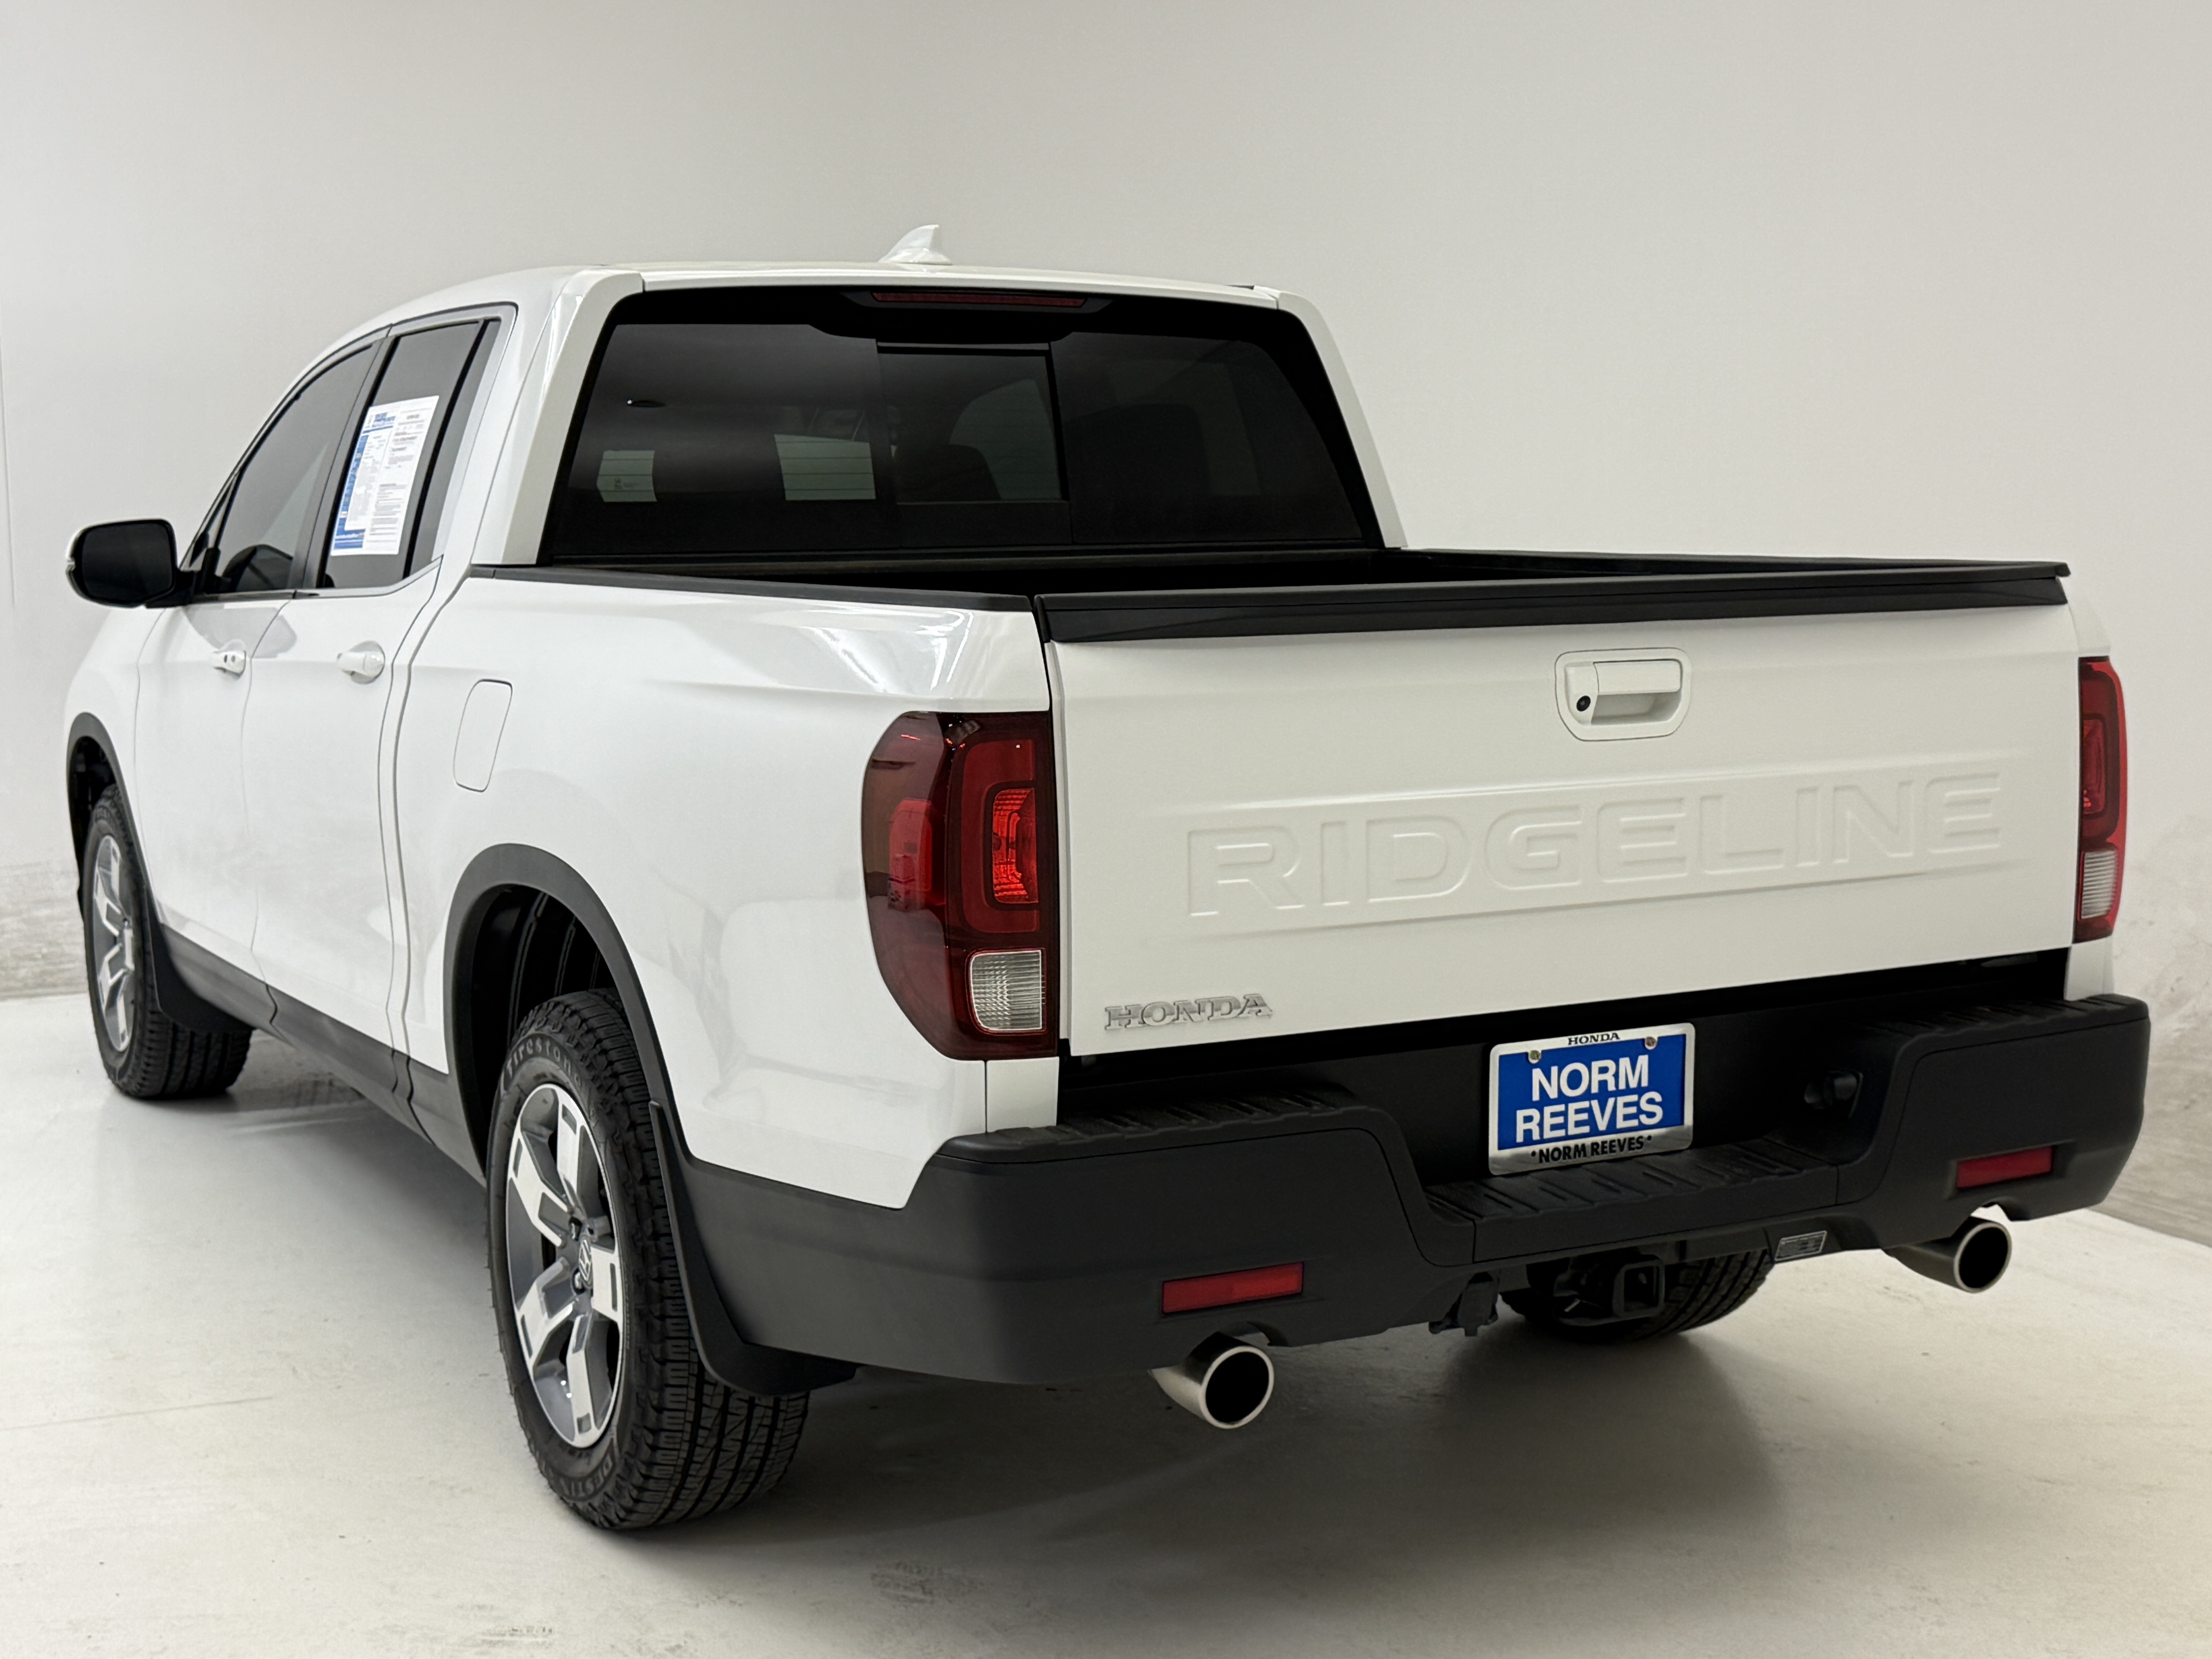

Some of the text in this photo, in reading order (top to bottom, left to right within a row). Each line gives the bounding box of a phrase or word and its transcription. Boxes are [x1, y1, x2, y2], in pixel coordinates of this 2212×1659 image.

[1188, 773, 2001, 917] RIDGELINE
[1104, 993, 1273, 1030] HONDA
[1568, 1032, 1620, 1045] HONDA
[1532, 1054, 1649, 1101] NORM
[1516, 1091, 1663, 1143] REEVES
[1539, 1136, 1644, 1163] NORM REEVES
